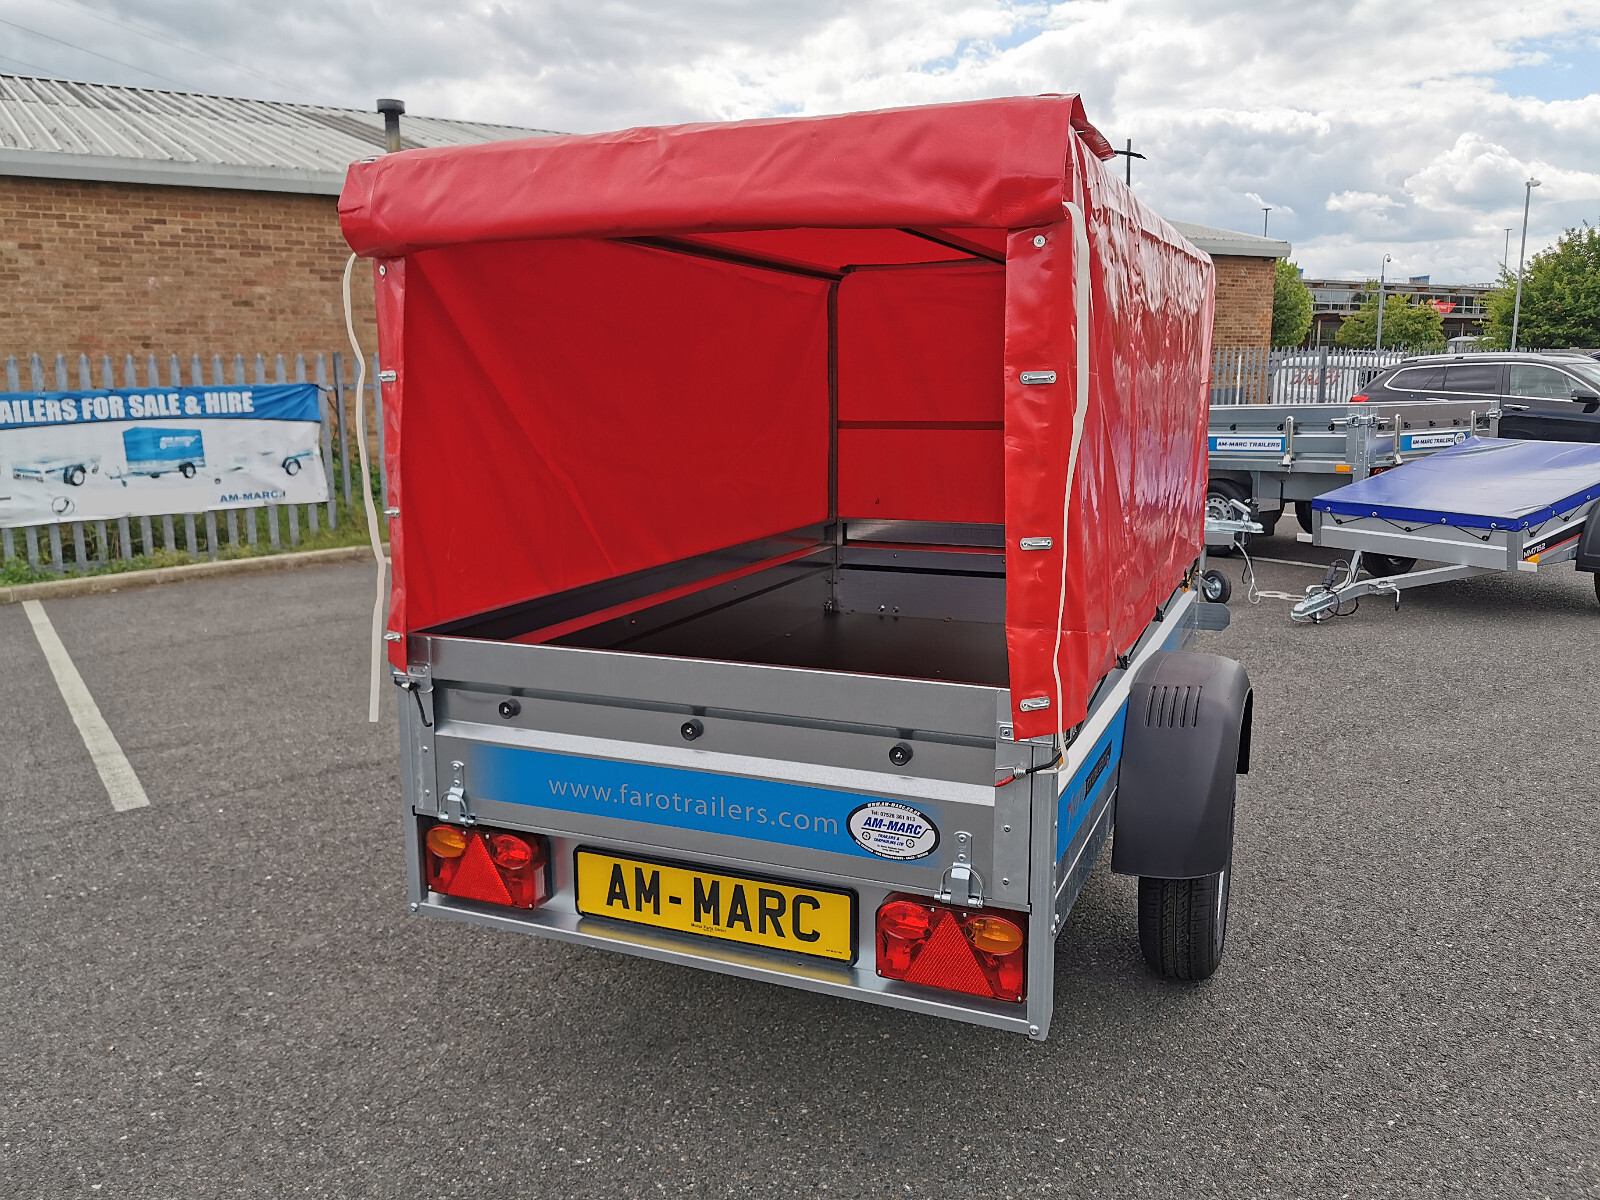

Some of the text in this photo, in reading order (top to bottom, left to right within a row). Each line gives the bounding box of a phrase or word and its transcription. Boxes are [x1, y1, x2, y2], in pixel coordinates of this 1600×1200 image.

[81, 395, 126, 420] FOR
[128, 393, 182, 418] SALE
[184, 395, 201, 416] &
[204, 391, 255, 415] HIRE
[1434, 437, 1454, 445] TRAILERS
[548, 779, 838, 834] www.farotrailers.com
[863, 817, 922, 835] AM-MARC
